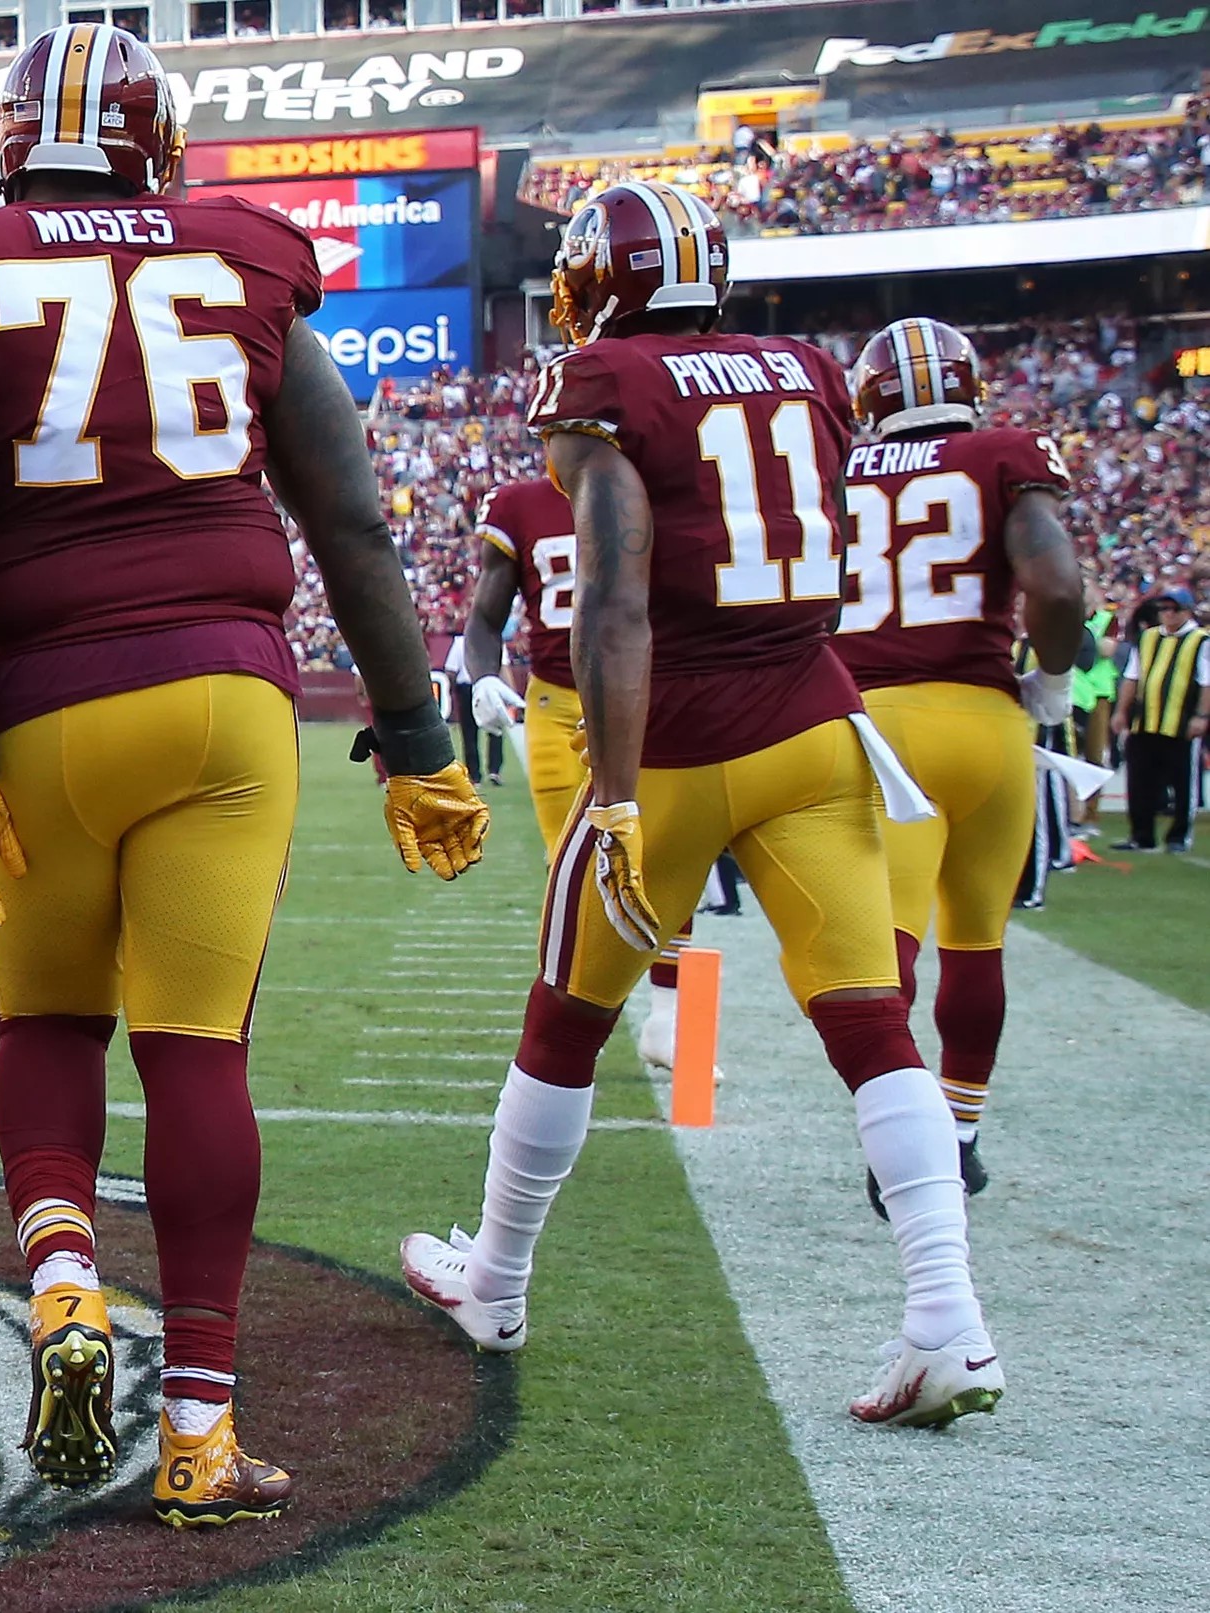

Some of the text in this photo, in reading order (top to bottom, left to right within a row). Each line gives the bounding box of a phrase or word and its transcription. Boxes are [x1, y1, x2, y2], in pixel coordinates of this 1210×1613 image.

[226, 136, 429, 176] REDSKINS
[29, 208, 174, 245] MOSES
[321, 194, 441, 228] America
[311, 314, 450, 376] epsi
[661, 350, 816, 398] PRYOR SR
[845, 438, 947, 478] PERINE
[696, 399, 841, 607] 11
[834, 470, 986, 635] 32
[56, 1295, 82, 1318] 7
[166, 1456, 194, 1491] 6
